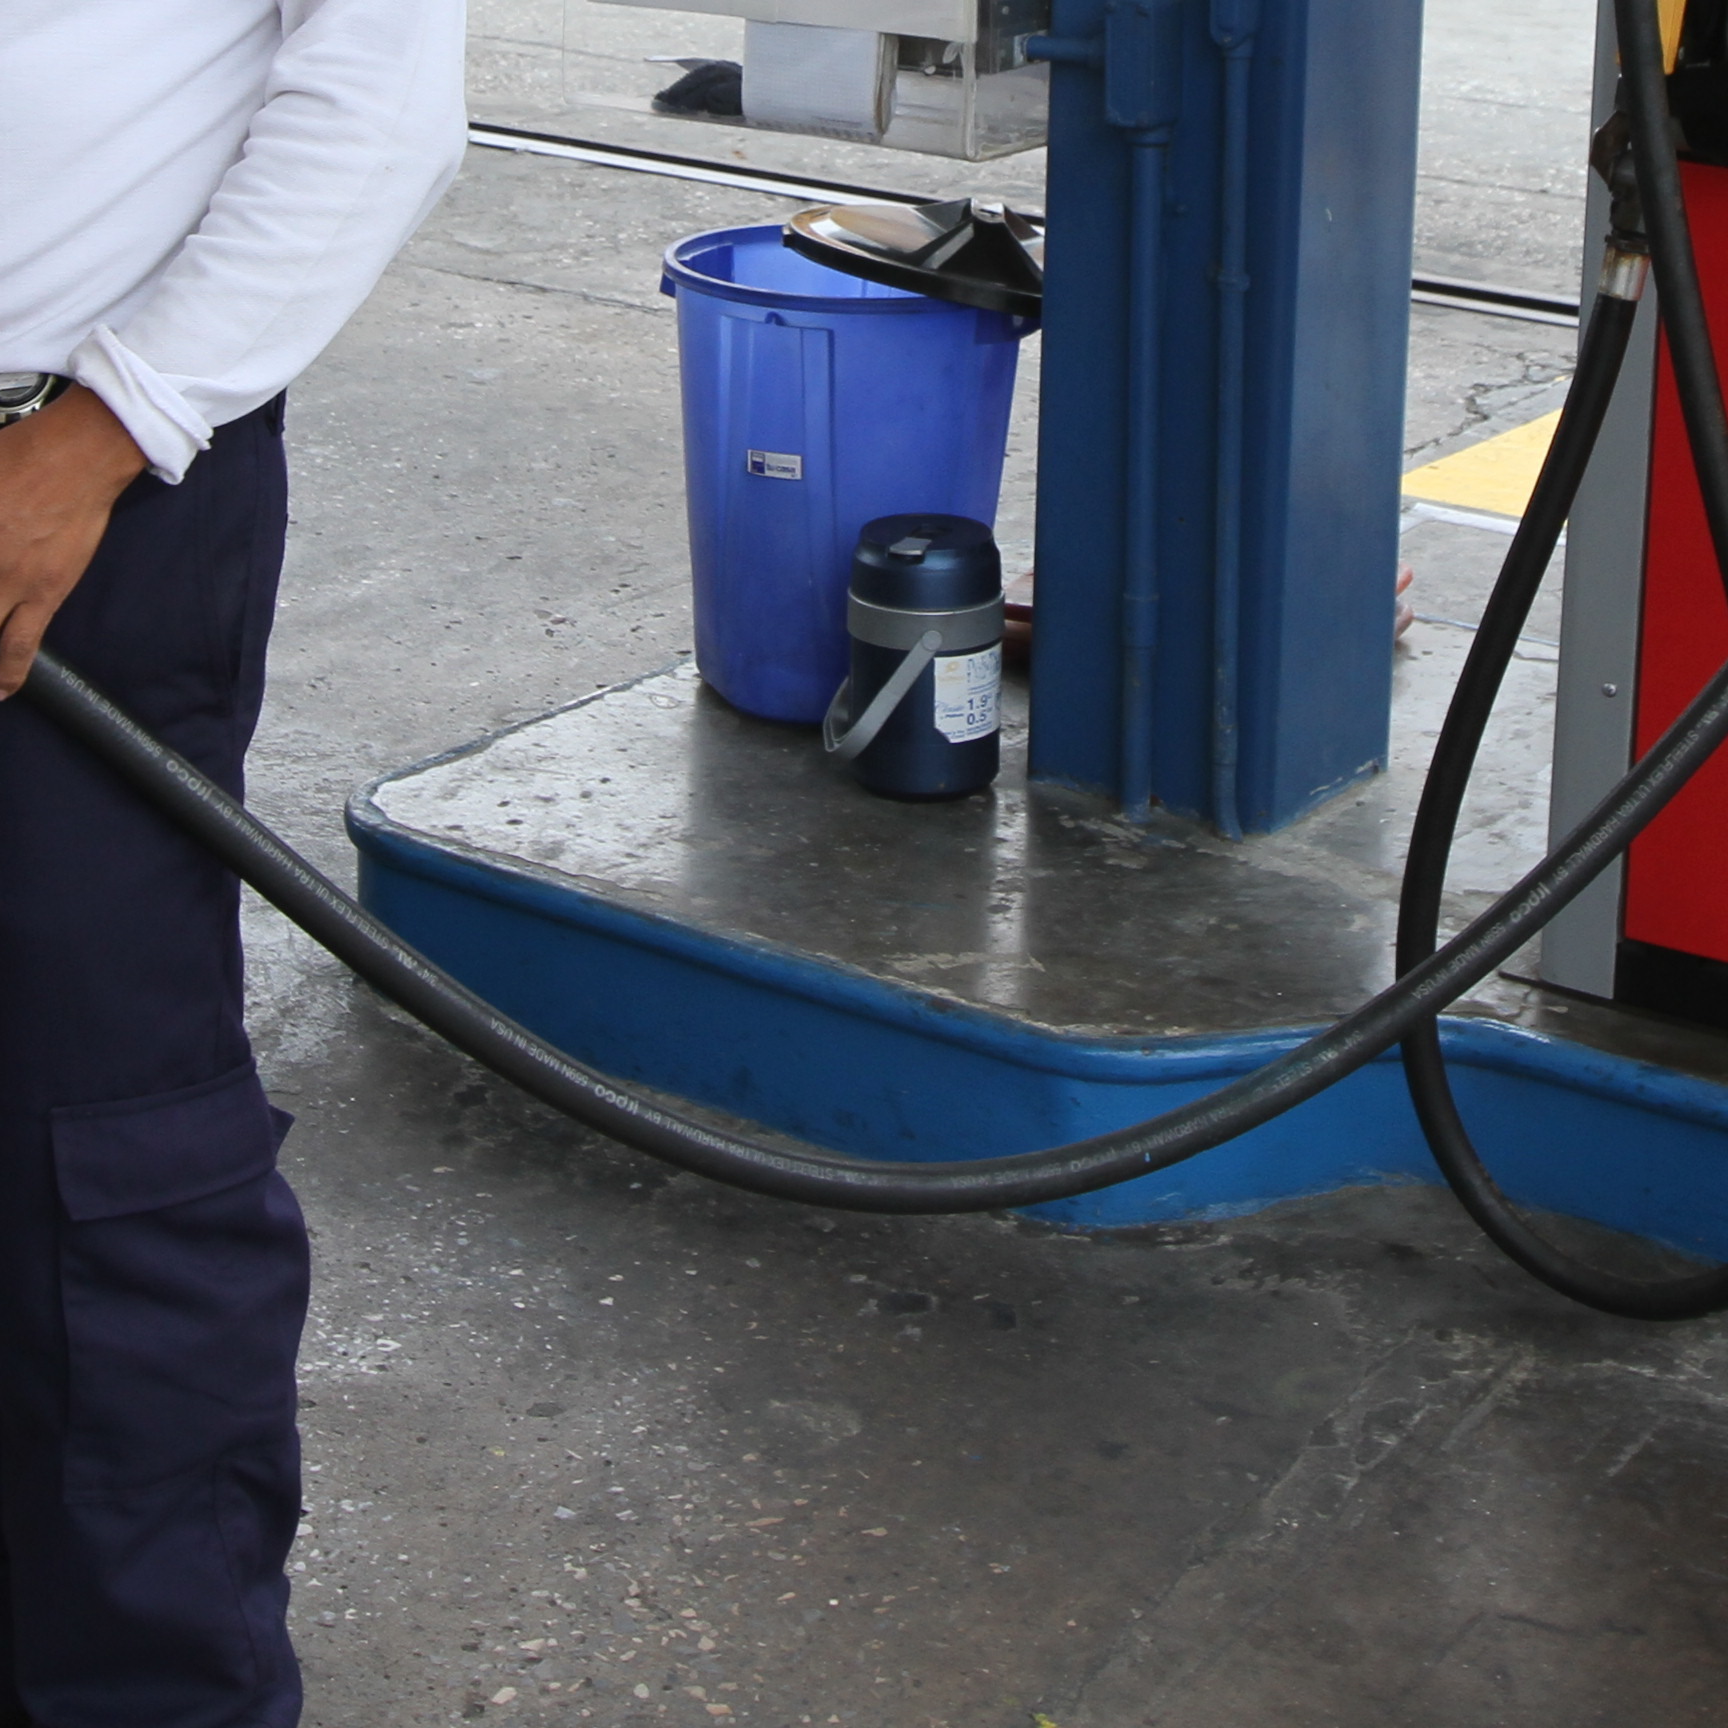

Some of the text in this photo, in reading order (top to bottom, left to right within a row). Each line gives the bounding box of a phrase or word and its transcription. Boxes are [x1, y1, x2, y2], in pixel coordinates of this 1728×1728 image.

[55, 664, 88, 694] USA
[81, 686, 101, 706] IN
[96, 698, 137, 735] MADE
[130, 726, 165, 758] 559N
[214, 798, 236, 820] BY
[232, 812, 295, 872] HARDWALL
[290, 862, 331, 902] ULTRA
[326, 892, 392, 952] STEELFLEX
[486, 1015, 515, 1040] USA
[512, 1033, 528, 1050] IN
[526, 1041, 563, 1070] MADE
[558, 1061, 591, 1088] 559N
[643, 1106, 664, 1126] BY
[664, 1116, 728, 1150] HARDWALL
[766, 1154, 834, 1181] STEELFLEX
